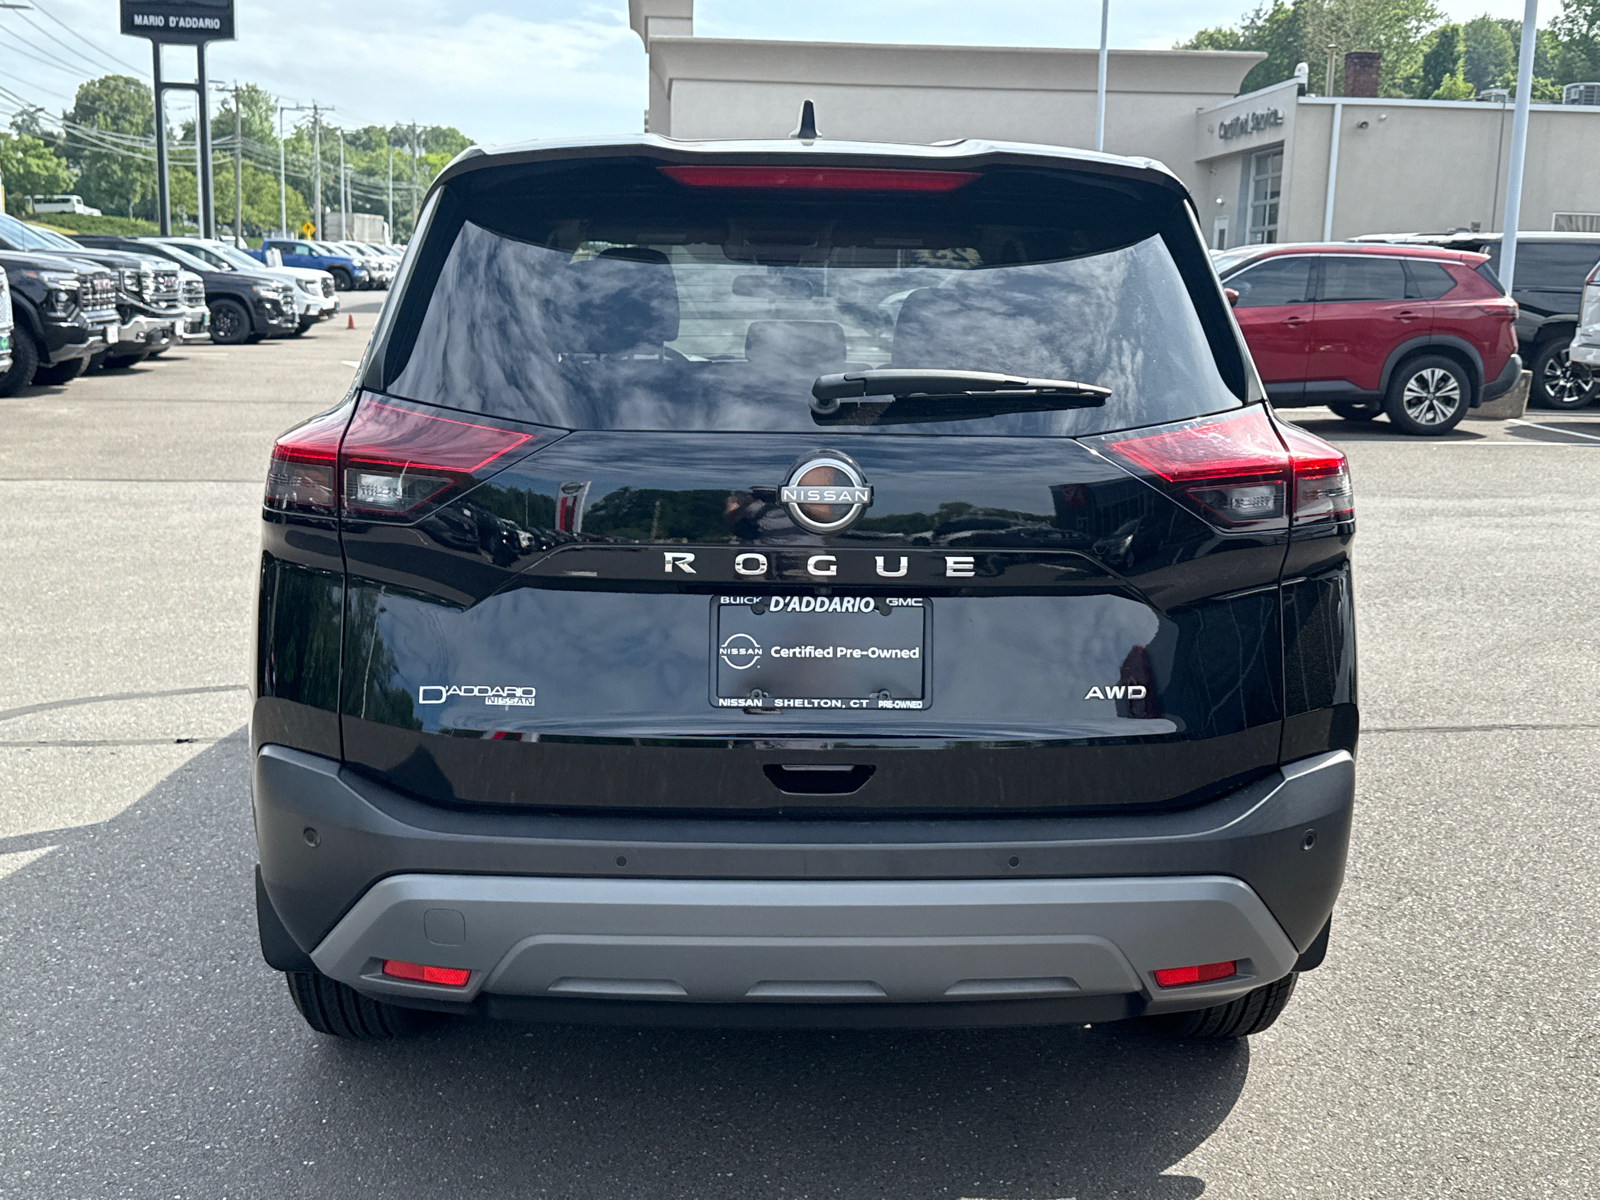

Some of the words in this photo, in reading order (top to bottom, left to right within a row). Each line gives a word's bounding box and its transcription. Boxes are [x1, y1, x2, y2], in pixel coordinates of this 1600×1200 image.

[134, 15, 165, 27] MARIO
[169, 16, 220, 29] D'ADDARIO
[783, 489, 868, 502] NISSAN
[664, 552, 975, 576] ROGUE
[720, 596, 762, 604] BUICK
[769, 595, 875, 613] D'ADDARIO
[886, 598, 923, 606] GMC
[770, 646, 833, 658] Certified
[836, 647, 920, 659] Pre-Owned
[419, 685, 536, 704] D'ADDARIO
[1084, 685, 1147, 700] AWD
[487, 697, 533, 705] NISSAN
[718, 699, 763, 707] NISSAN
[774, 699, 846, 709] SHELTON,
[850, 700, 869, 708] CT
[878, 701, 923, 709] PRE-OWNED
